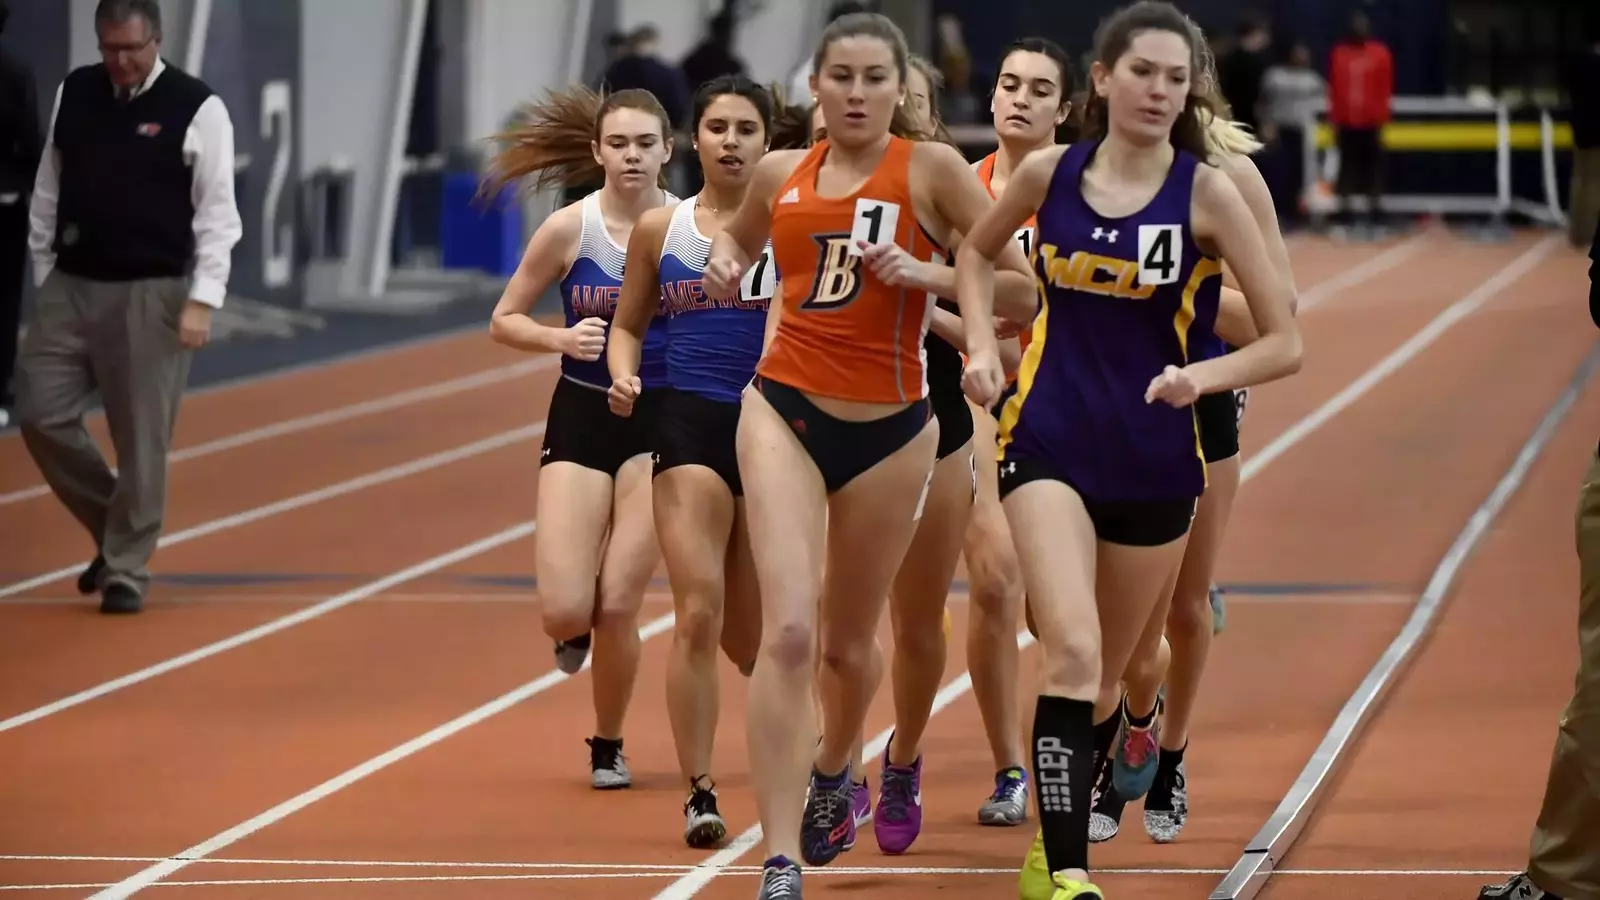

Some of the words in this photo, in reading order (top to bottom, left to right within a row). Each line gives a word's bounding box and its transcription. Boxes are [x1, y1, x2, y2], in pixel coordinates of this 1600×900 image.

[260, 81, 293, 287] 2
[862, 205, 883, 245] 1
[1144, 229, 1175, 279] 4
[801, 234, 863, 309] B
